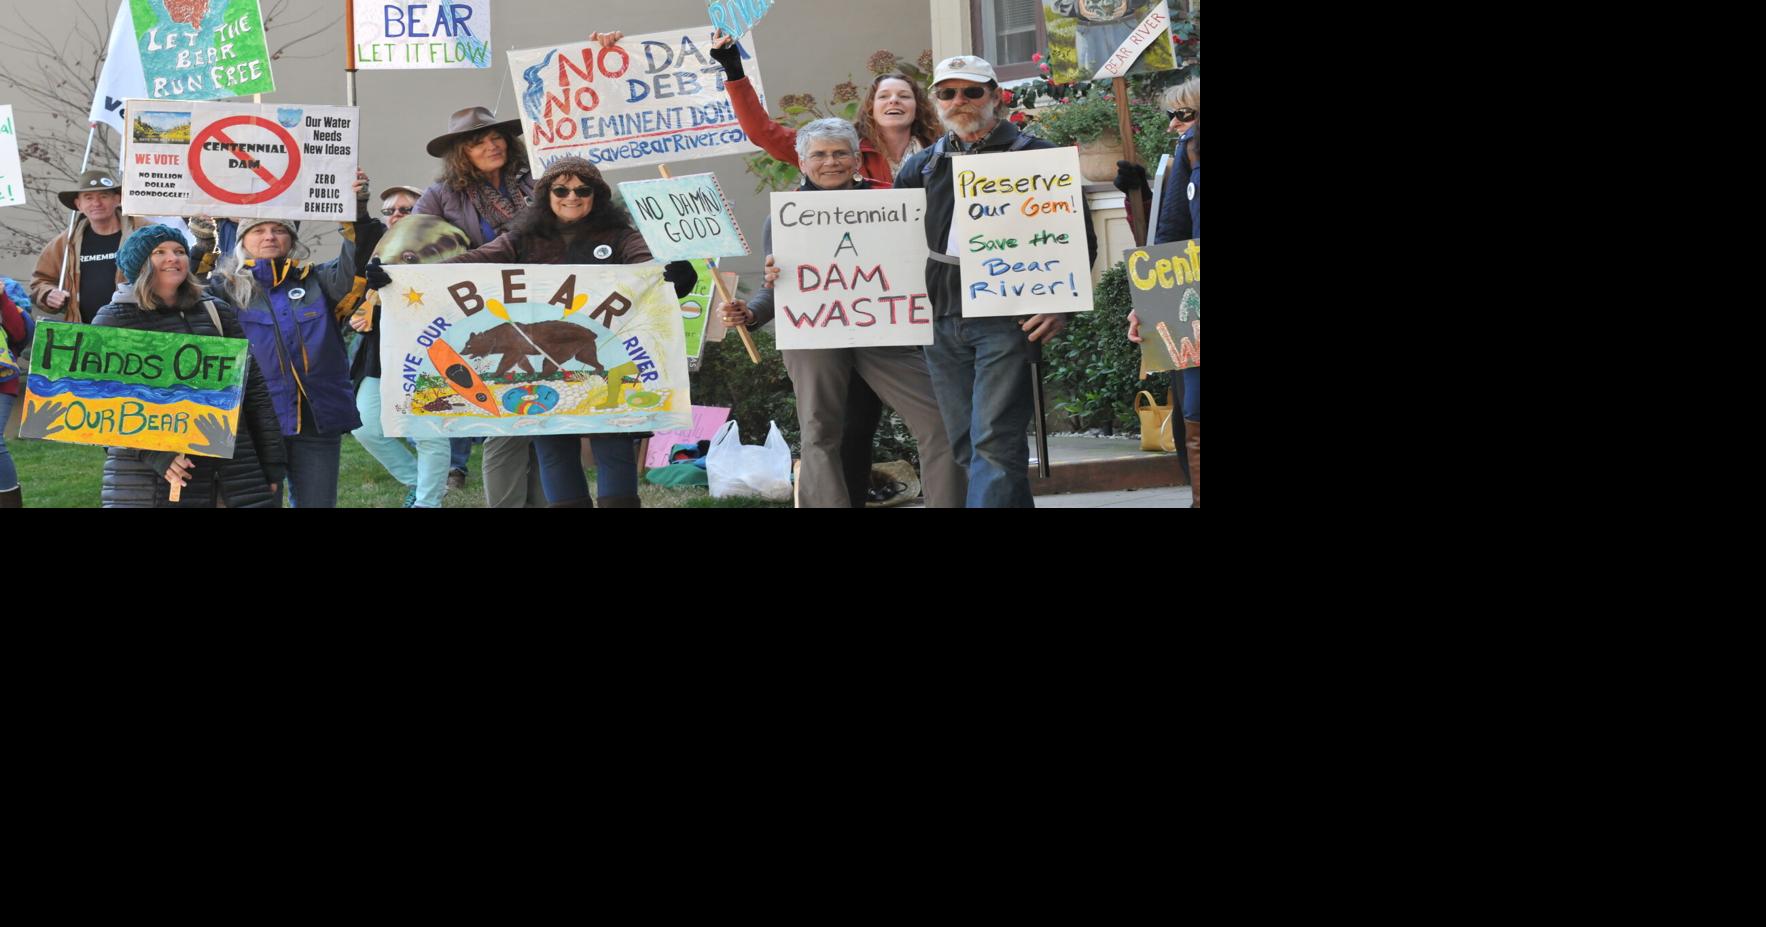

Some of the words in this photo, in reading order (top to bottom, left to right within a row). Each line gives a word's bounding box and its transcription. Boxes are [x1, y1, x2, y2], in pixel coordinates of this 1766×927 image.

[147, 28, 198, 51] LET
[215, 15, 251, 42] THE
[384, 4, 473, 38] BEAR
[175, 43, 236, 69] BEAR
[358, 43, 396, 62] LET
[406, 43, 424, 62] IT
[430, 40, 488, 64] FLOW
[1104, 47, 1134, 75] BEAR
[1130, 12, 1167, 46] RIVER
[153, 74, 202, 97] RUN
[210, 60, 262, 89] FREE
[557, 45, 630, 88] NO
[543, 86, 600, 118] NO
[626, 66, 728, 103] DEBT
[305, 116, 322, 128] Our
[323, 117, 351, 129] Water
[532, 117, 578, 145] NO
[581, 106, 684, 139] EMINENT
[203, 141, 287, 154] CENTENNIAL
[313, 130, 342, 142] Needs
[135, 154, 151, 165] WE
[154, 154, 180, 165] VOTE
[304, 143, 323, 155] New
[325, 143, 351, 156] Ideas
[228, 159, 261, 169] DAM
[315, 174, 336, 185] ZERO
[958, 170, 1073, 198] Preserve
[309, 188, 340, 199] PUBLIC
[1020, 195, 1077, 218] Gem!
[304, 202, 344, 214] BENEFITS
[635, 197, 663, 220] NO
[664, 217, 720, 242] GOOD
[968, 235, 1018, 253] Save
[1028, 229, 1070, 247] the
[834, 231, 858, 258] A
[797, 263, 890, 292] DAM
[982, 258, 1060, 277] Bear
[969, 272, 1079, 300] River!
[783, 293, 930, 329] WASTE
[403, 353, 423, 393] SAVE
[416, 316, 452, 348] OUR
[447, 268, 632, 329] BEAR
[622, 335, 659, 383] RIVER
[174, 343, 236, 381] OFF
[64, 400, 115, 433] OUR
[118, 400, 190, 435] BEAR
